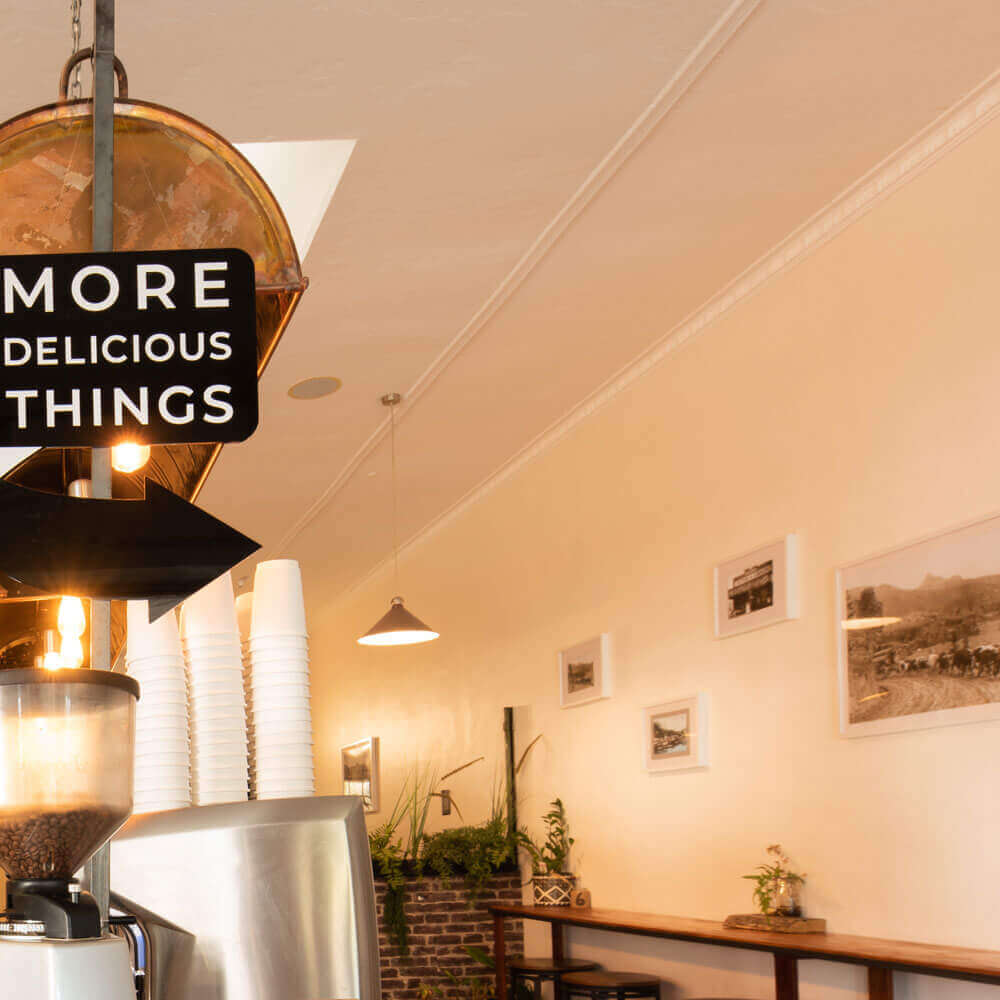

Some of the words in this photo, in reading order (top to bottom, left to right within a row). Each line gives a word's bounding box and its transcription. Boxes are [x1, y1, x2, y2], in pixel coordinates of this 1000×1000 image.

[3, 261, 230, 314] MORE
[3, 331, 233, 366] DELICIOUS
[5, 384, 235, 429] THINGS
